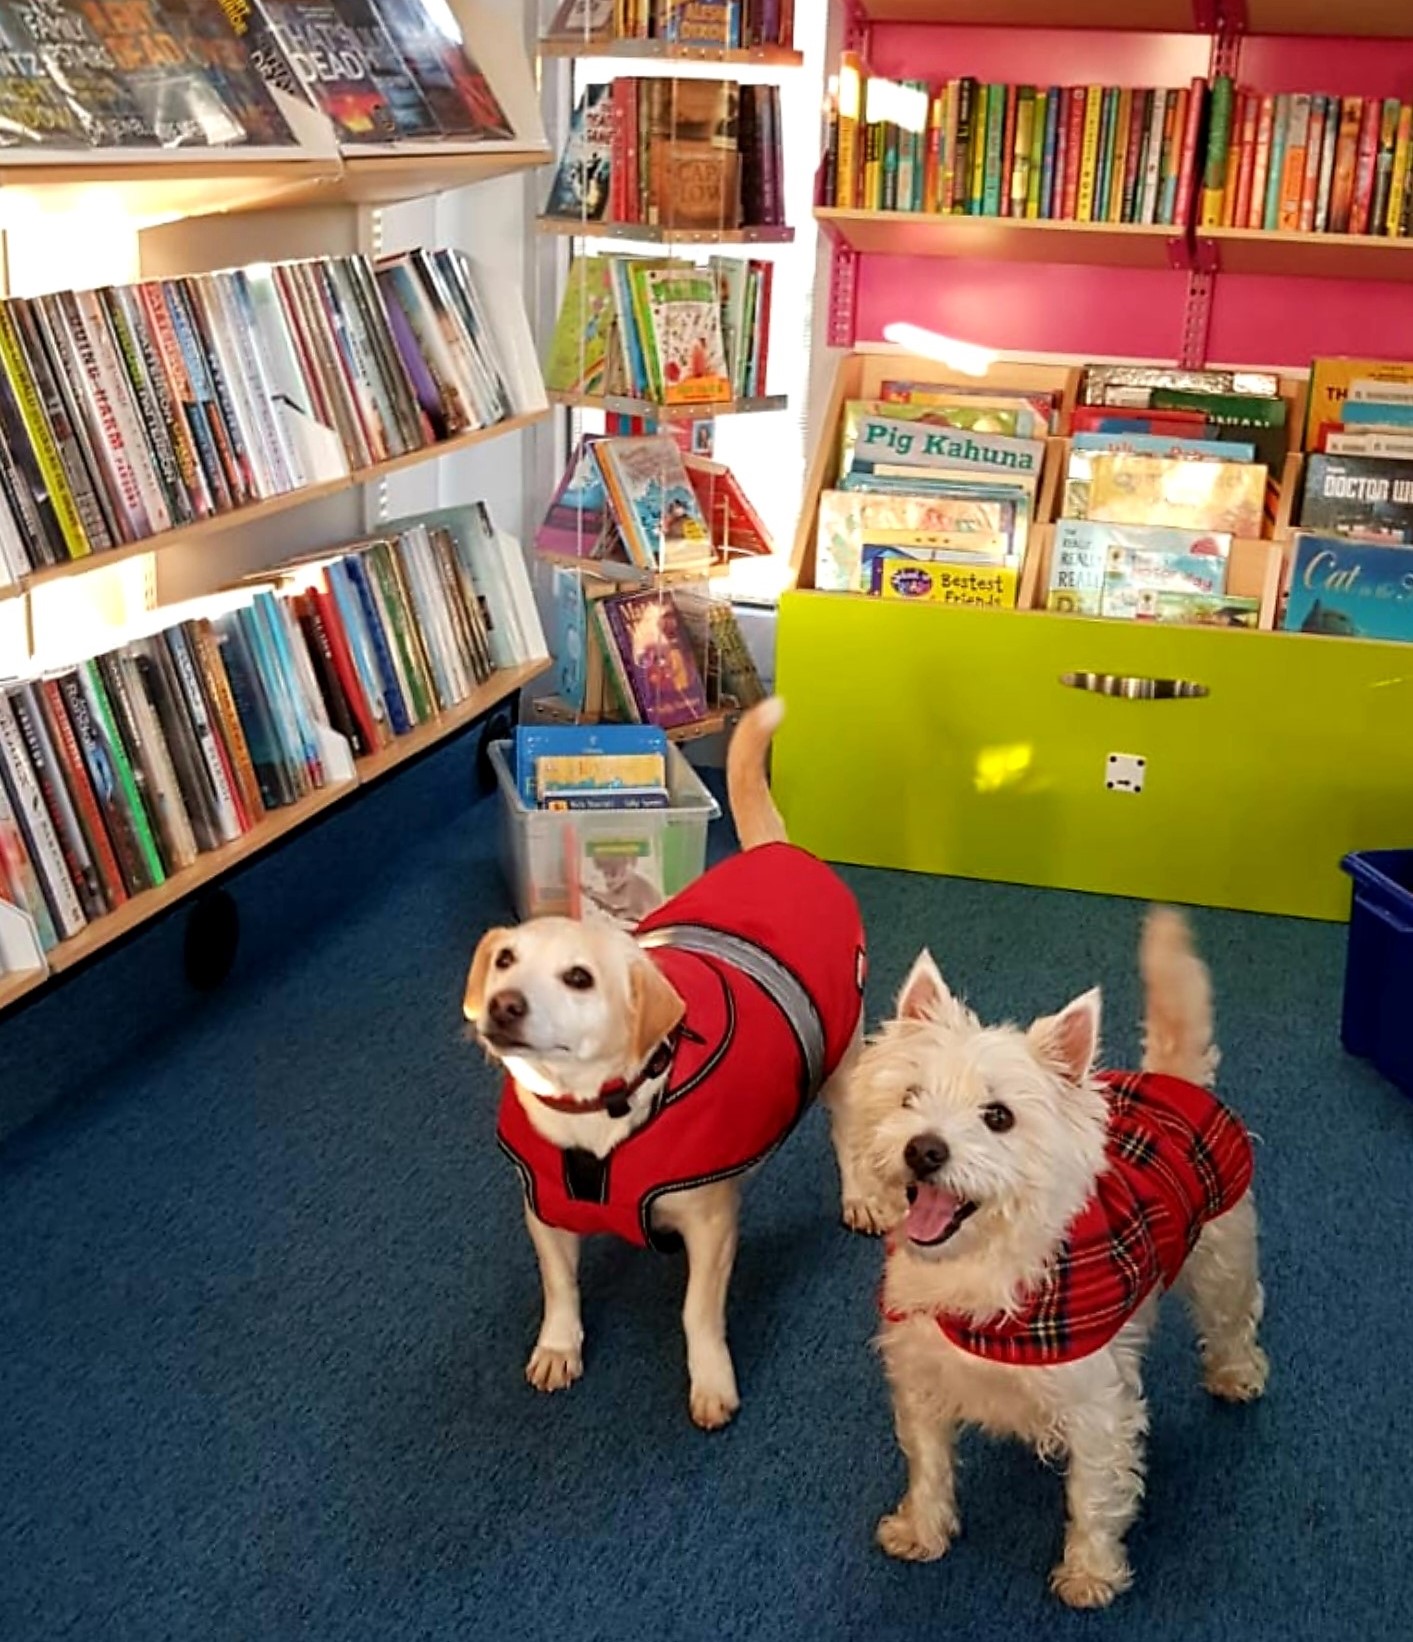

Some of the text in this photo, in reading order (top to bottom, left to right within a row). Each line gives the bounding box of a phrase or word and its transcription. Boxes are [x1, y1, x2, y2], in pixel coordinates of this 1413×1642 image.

[289, 51, 365, 81] DEAD
[1326, 385, 1348, 401] TH
[93, 387, 125, 451] HARM
[864, 423, 1034, 469] Pig Kahuna
[1324, 474, 1389, 501] DOCTOR
[941, 573, 1004, 593] Bestest
[1303, 550, 1361, 592] Cat
